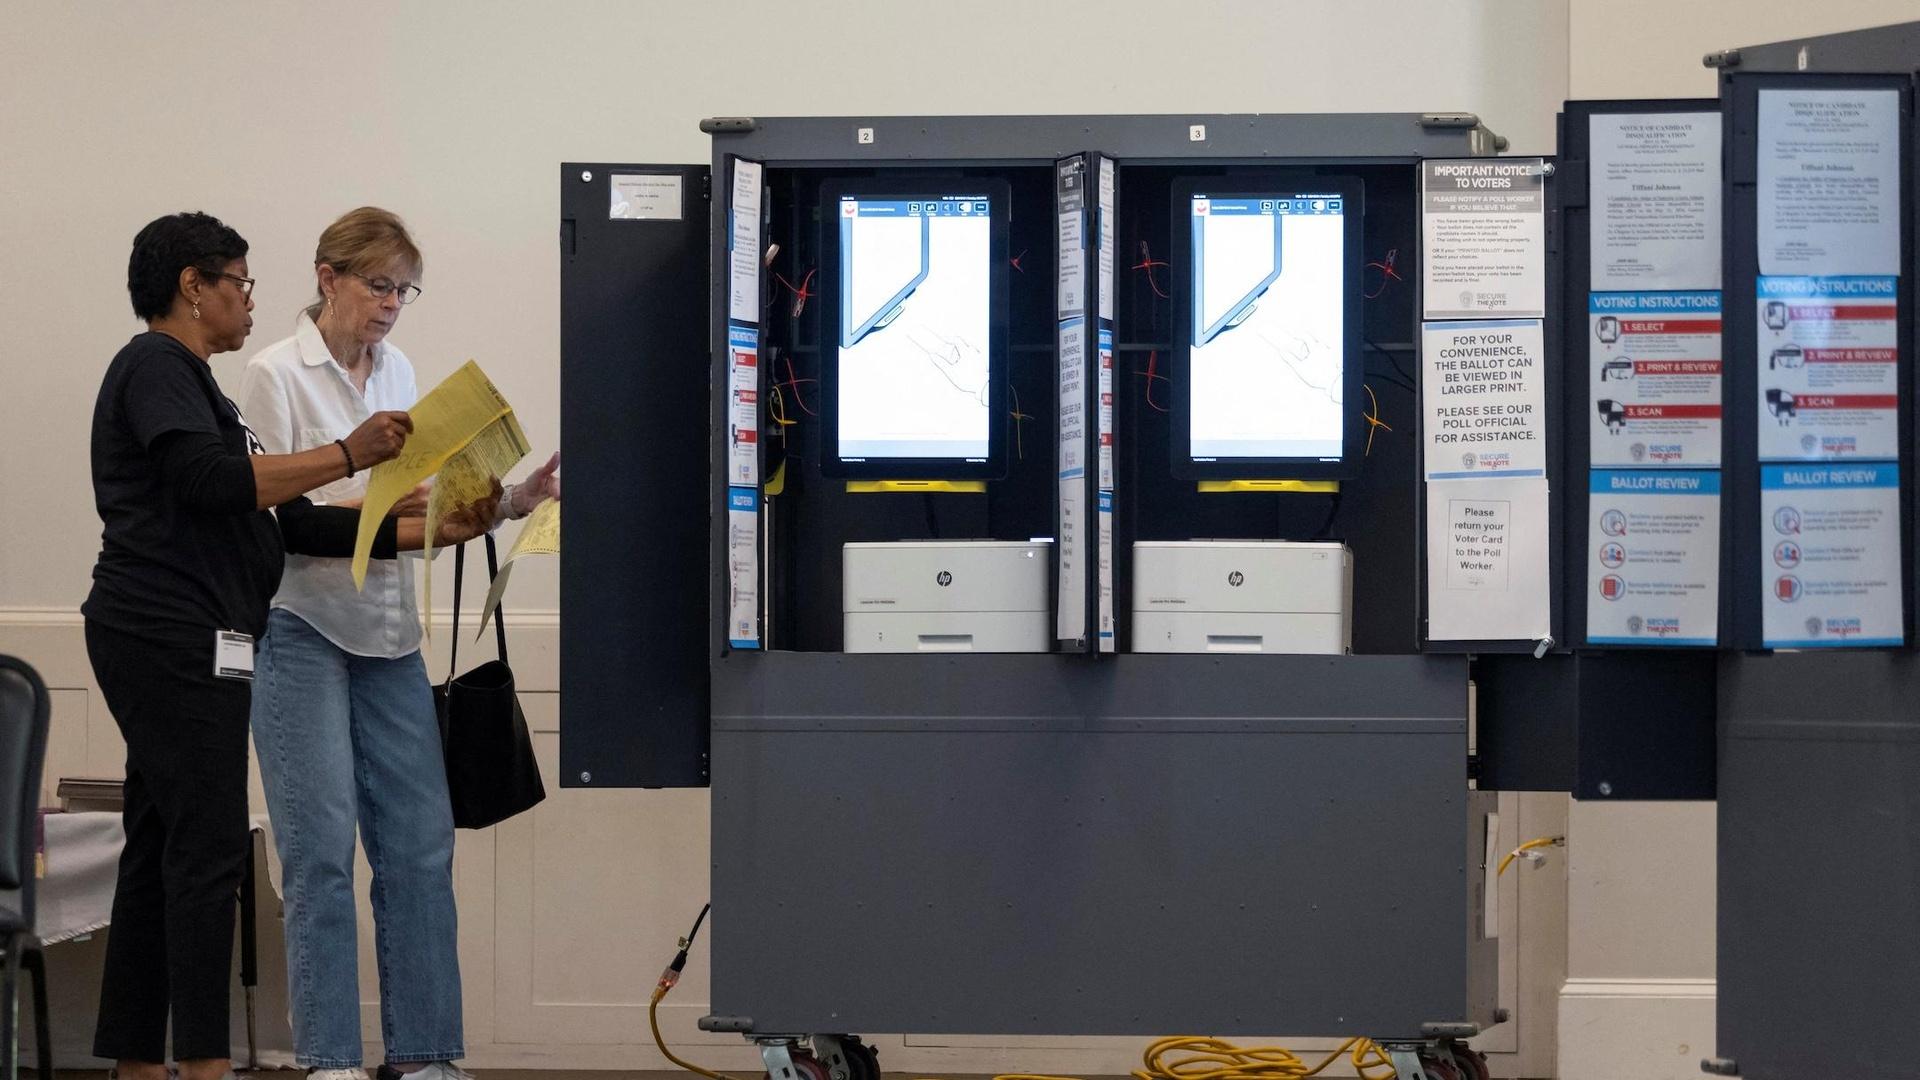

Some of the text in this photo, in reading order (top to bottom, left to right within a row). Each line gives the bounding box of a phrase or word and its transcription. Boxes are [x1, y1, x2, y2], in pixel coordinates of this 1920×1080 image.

[1435, 166, 1532, 176] IMPORTANT NOTICE
[1455, 178, 1511, 188] TO VOTERS
[1762, 280, 1893, 292] VOTING INSTRUCTIONS
[1594, 296, 1719, 308] VOTING INSTRUCTIONS
[1801, 308, 1836, 317] SELECT
[1453, 334, 1512, 345] FOR YOUR
[1440, 346, 1526, 358] CONVENIENCE,
[1818, 351, 1845, 360] PRINT
[1855, 351, 1892, 360] REVIEW
[1435, 358, 1532, 370] THE BALLOT CAN
[1638, 363, 1717, 371] 2. PRINT & REVIEW
[1445, 371, 1522, 382] BE VIEWED IN
[1442, 383, 1527, 395] LARGER PRINT.
[1808, 398, 1835, 406] SCAN
[1437, 405, 1532, 417] PLEASE SEE OUR
[1628, 408, 1662, 416] 3. SCAN
[1443, 417, 1526, 429] POLL OFFICIAL
[1435, 431, 1536, 443] FOR ASSISTANCE.
[1649, 444, 1682, 453] SECURE
[1611, 477, 1699, 489] BALLOT REVIEW
[1783, 471, 1877, 485] BALLOT REVIEW
[1465, 508, 1494, 517] Please
[1455, 522, 1504, 532] return your
[1455, 534, 1503, 544] Voter Card
[1467, 548, 1481, 556] the
[1483, 549, 1501, 557] Poll
[1460, 561, 1495, 571] Worker.
[937, 571, 952, 586] hp
[1228, 571, 1243, 586] hp
[1647, 618, 1679, 626] SECURE
